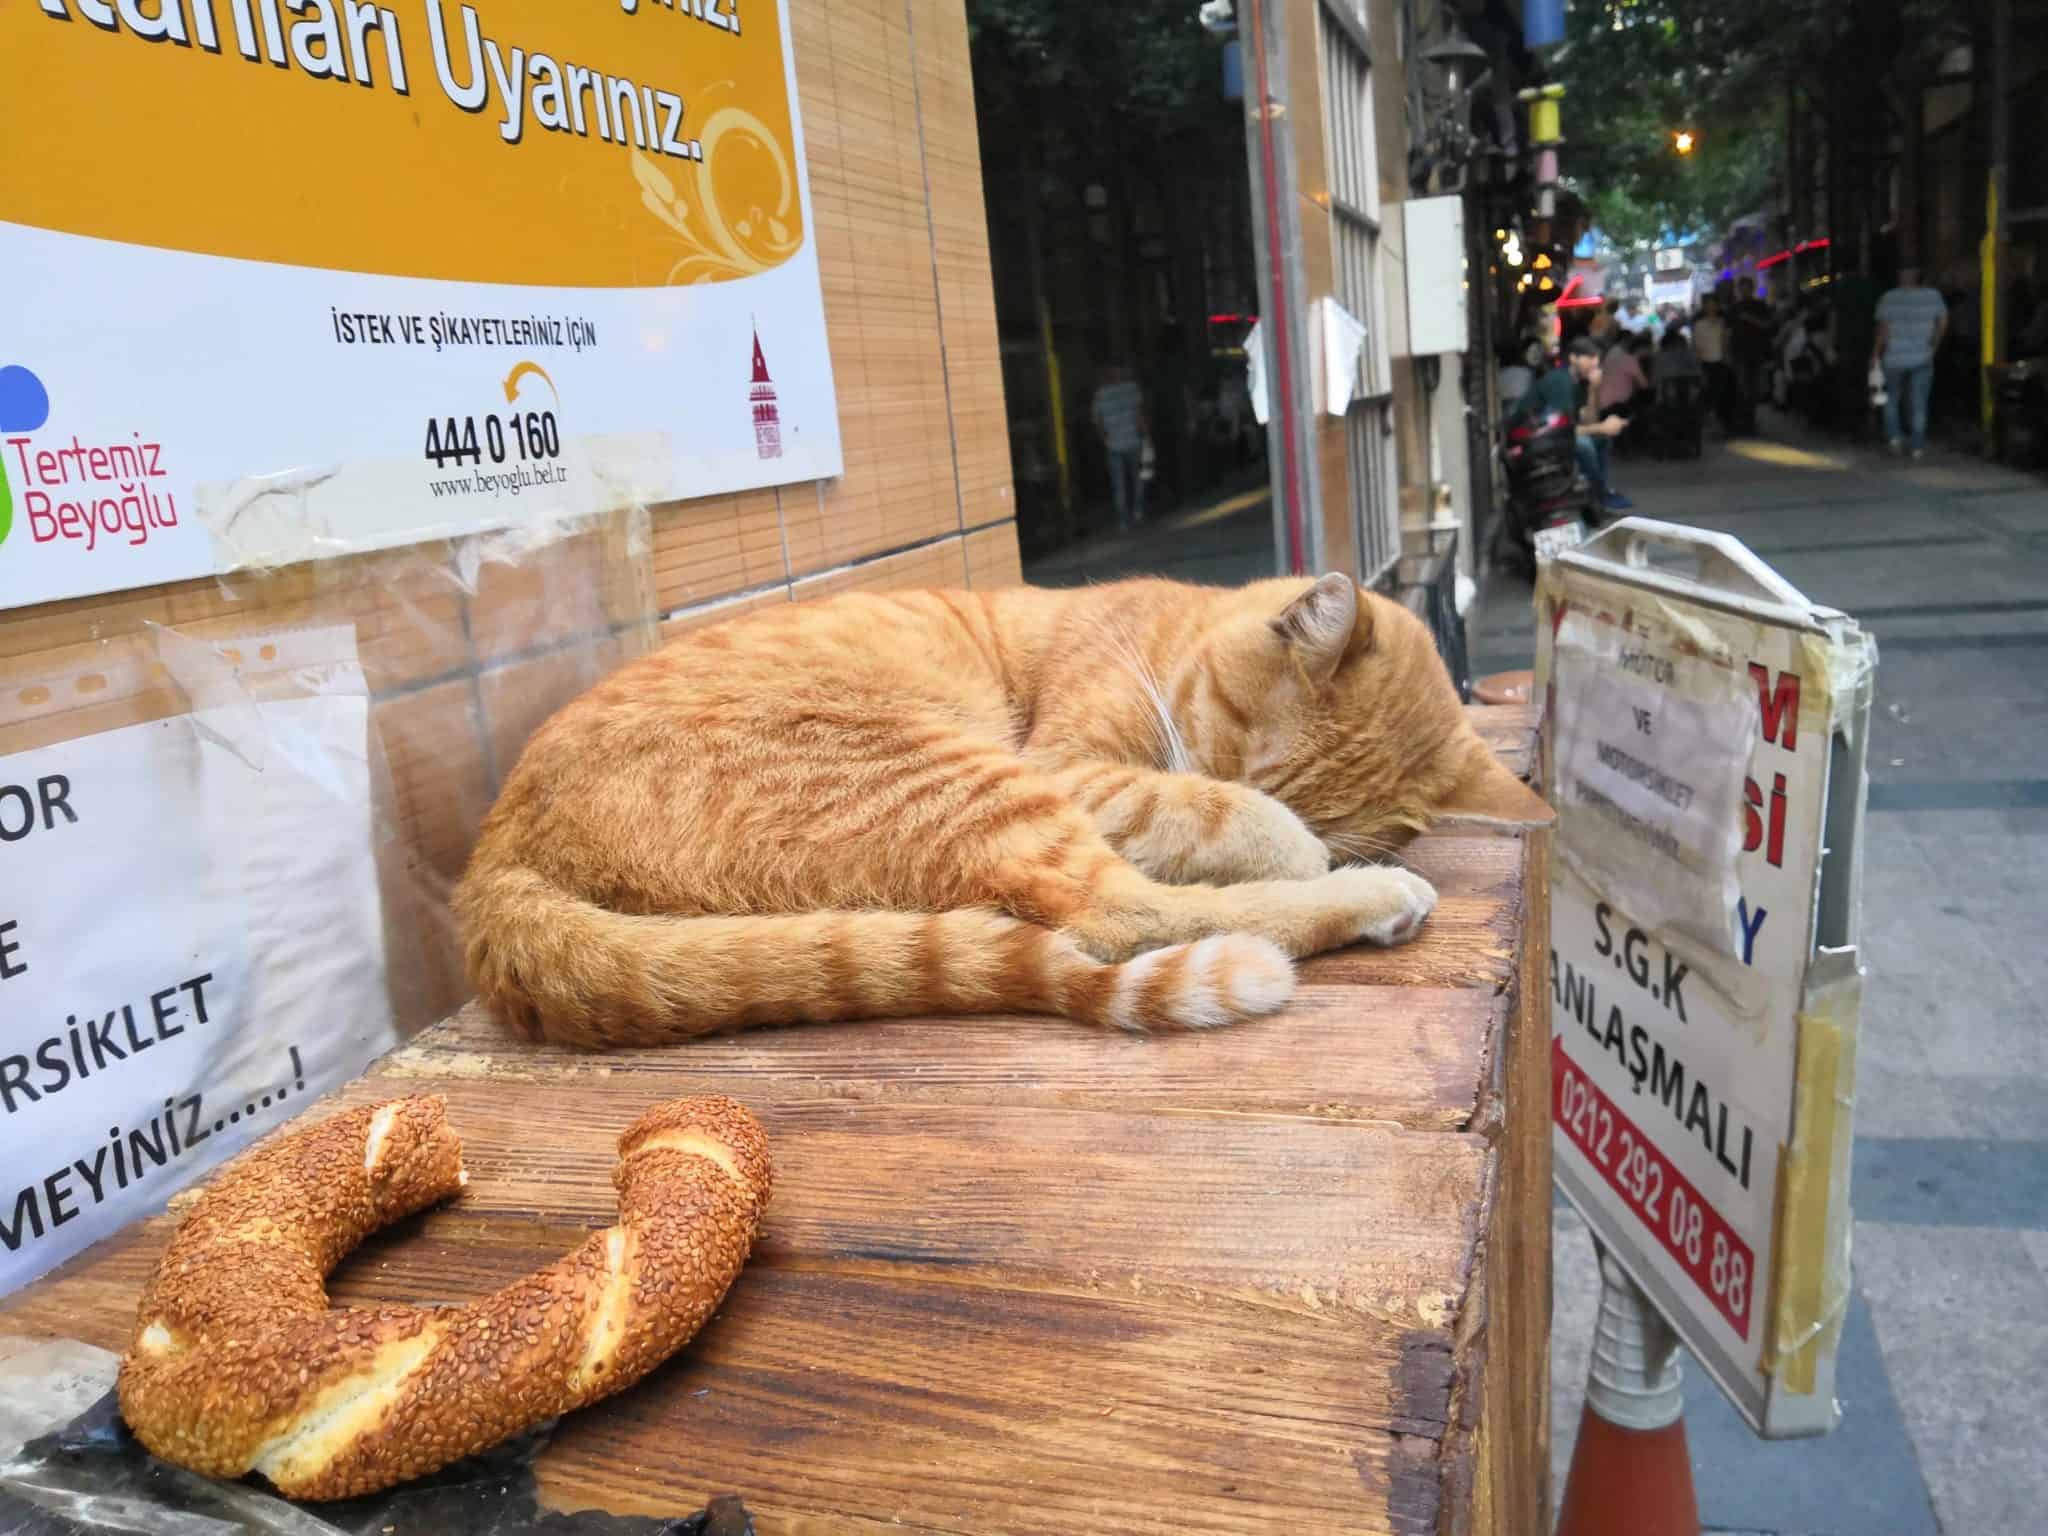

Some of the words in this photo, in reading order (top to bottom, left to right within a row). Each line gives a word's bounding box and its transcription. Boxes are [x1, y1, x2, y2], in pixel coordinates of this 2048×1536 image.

[425, 0, 704, 162] Uyarınız.
[331, 306, 396, 344] İSTEK
[398, 315, 425, 344] VE
[429, 311, 564, 352] ŞİKAYETLERİNİZ
[565, 316, 597, 352] İÇİN
[6, 431, 167, 487] Tertemiz
[425, 416, 480, 468] 444
[486, 414, 506, 463] 0
[510, 410, 560, 460] 160
[429, 464, 568, 498] www.beyoglu.bel.tr
[24, 482, 178, 551] Beyoğlu
[1594, 902, 1689, 1024] S.G.K
[0, 972, 213, 1114] RSİKLET
[1561, 1070, 1611, 1165] 0212
[1615, 1143, 1660, 1222] 292
[1669, 1187, 1705, 1266] 08
[1711, 1235, 1748, 1318] 88
